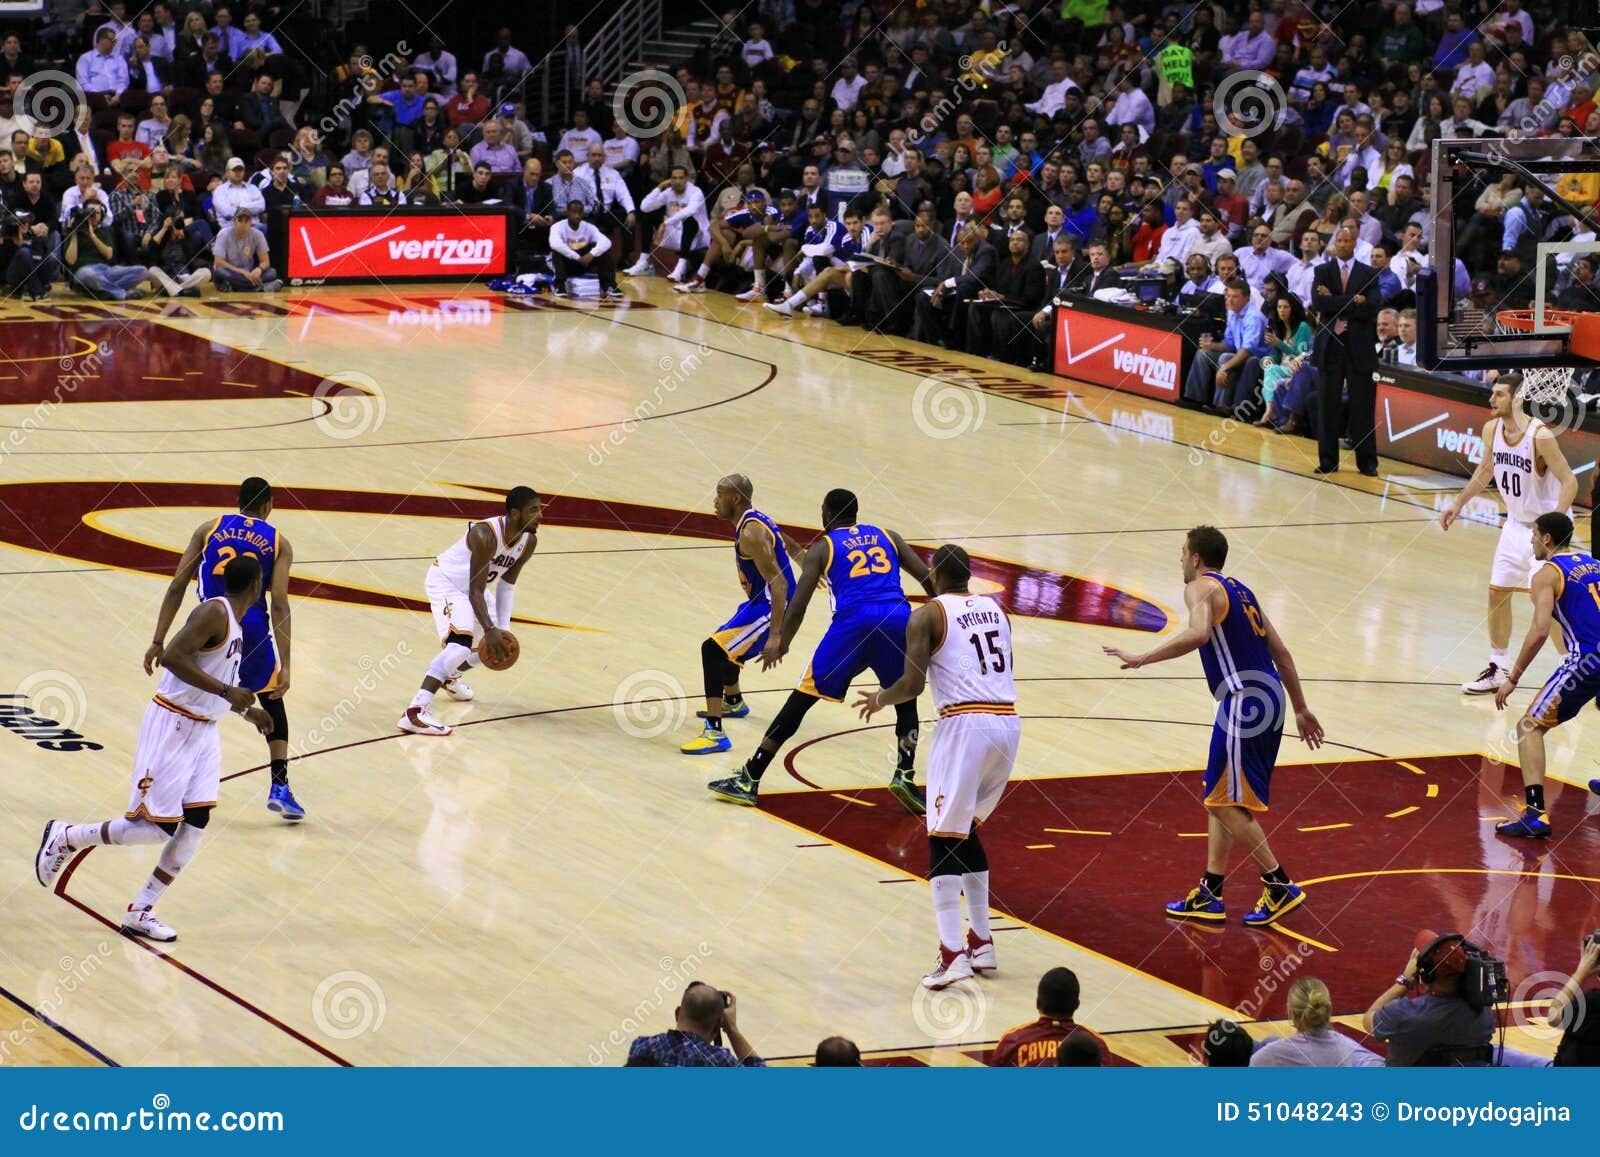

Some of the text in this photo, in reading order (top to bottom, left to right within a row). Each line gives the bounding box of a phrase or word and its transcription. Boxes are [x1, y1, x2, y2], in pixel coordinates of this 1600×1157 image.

[388, 233, 494, 265] verizon
[1112, 347, 1177, 390] verizon
[1436, 427, 1485, 464] veriz
[1501, 470, 1522, 498] 40
[213, 527, 274, 555] BAZEMORE
[842, 534, 878, 549] GREEN
[846, 546, 892, 579] 23
[956, 611, 1000, 630] SPEIGHTS
[969, 630, 1006, 676] 15
[1018, 1040, 1062, 1067] CAVA
